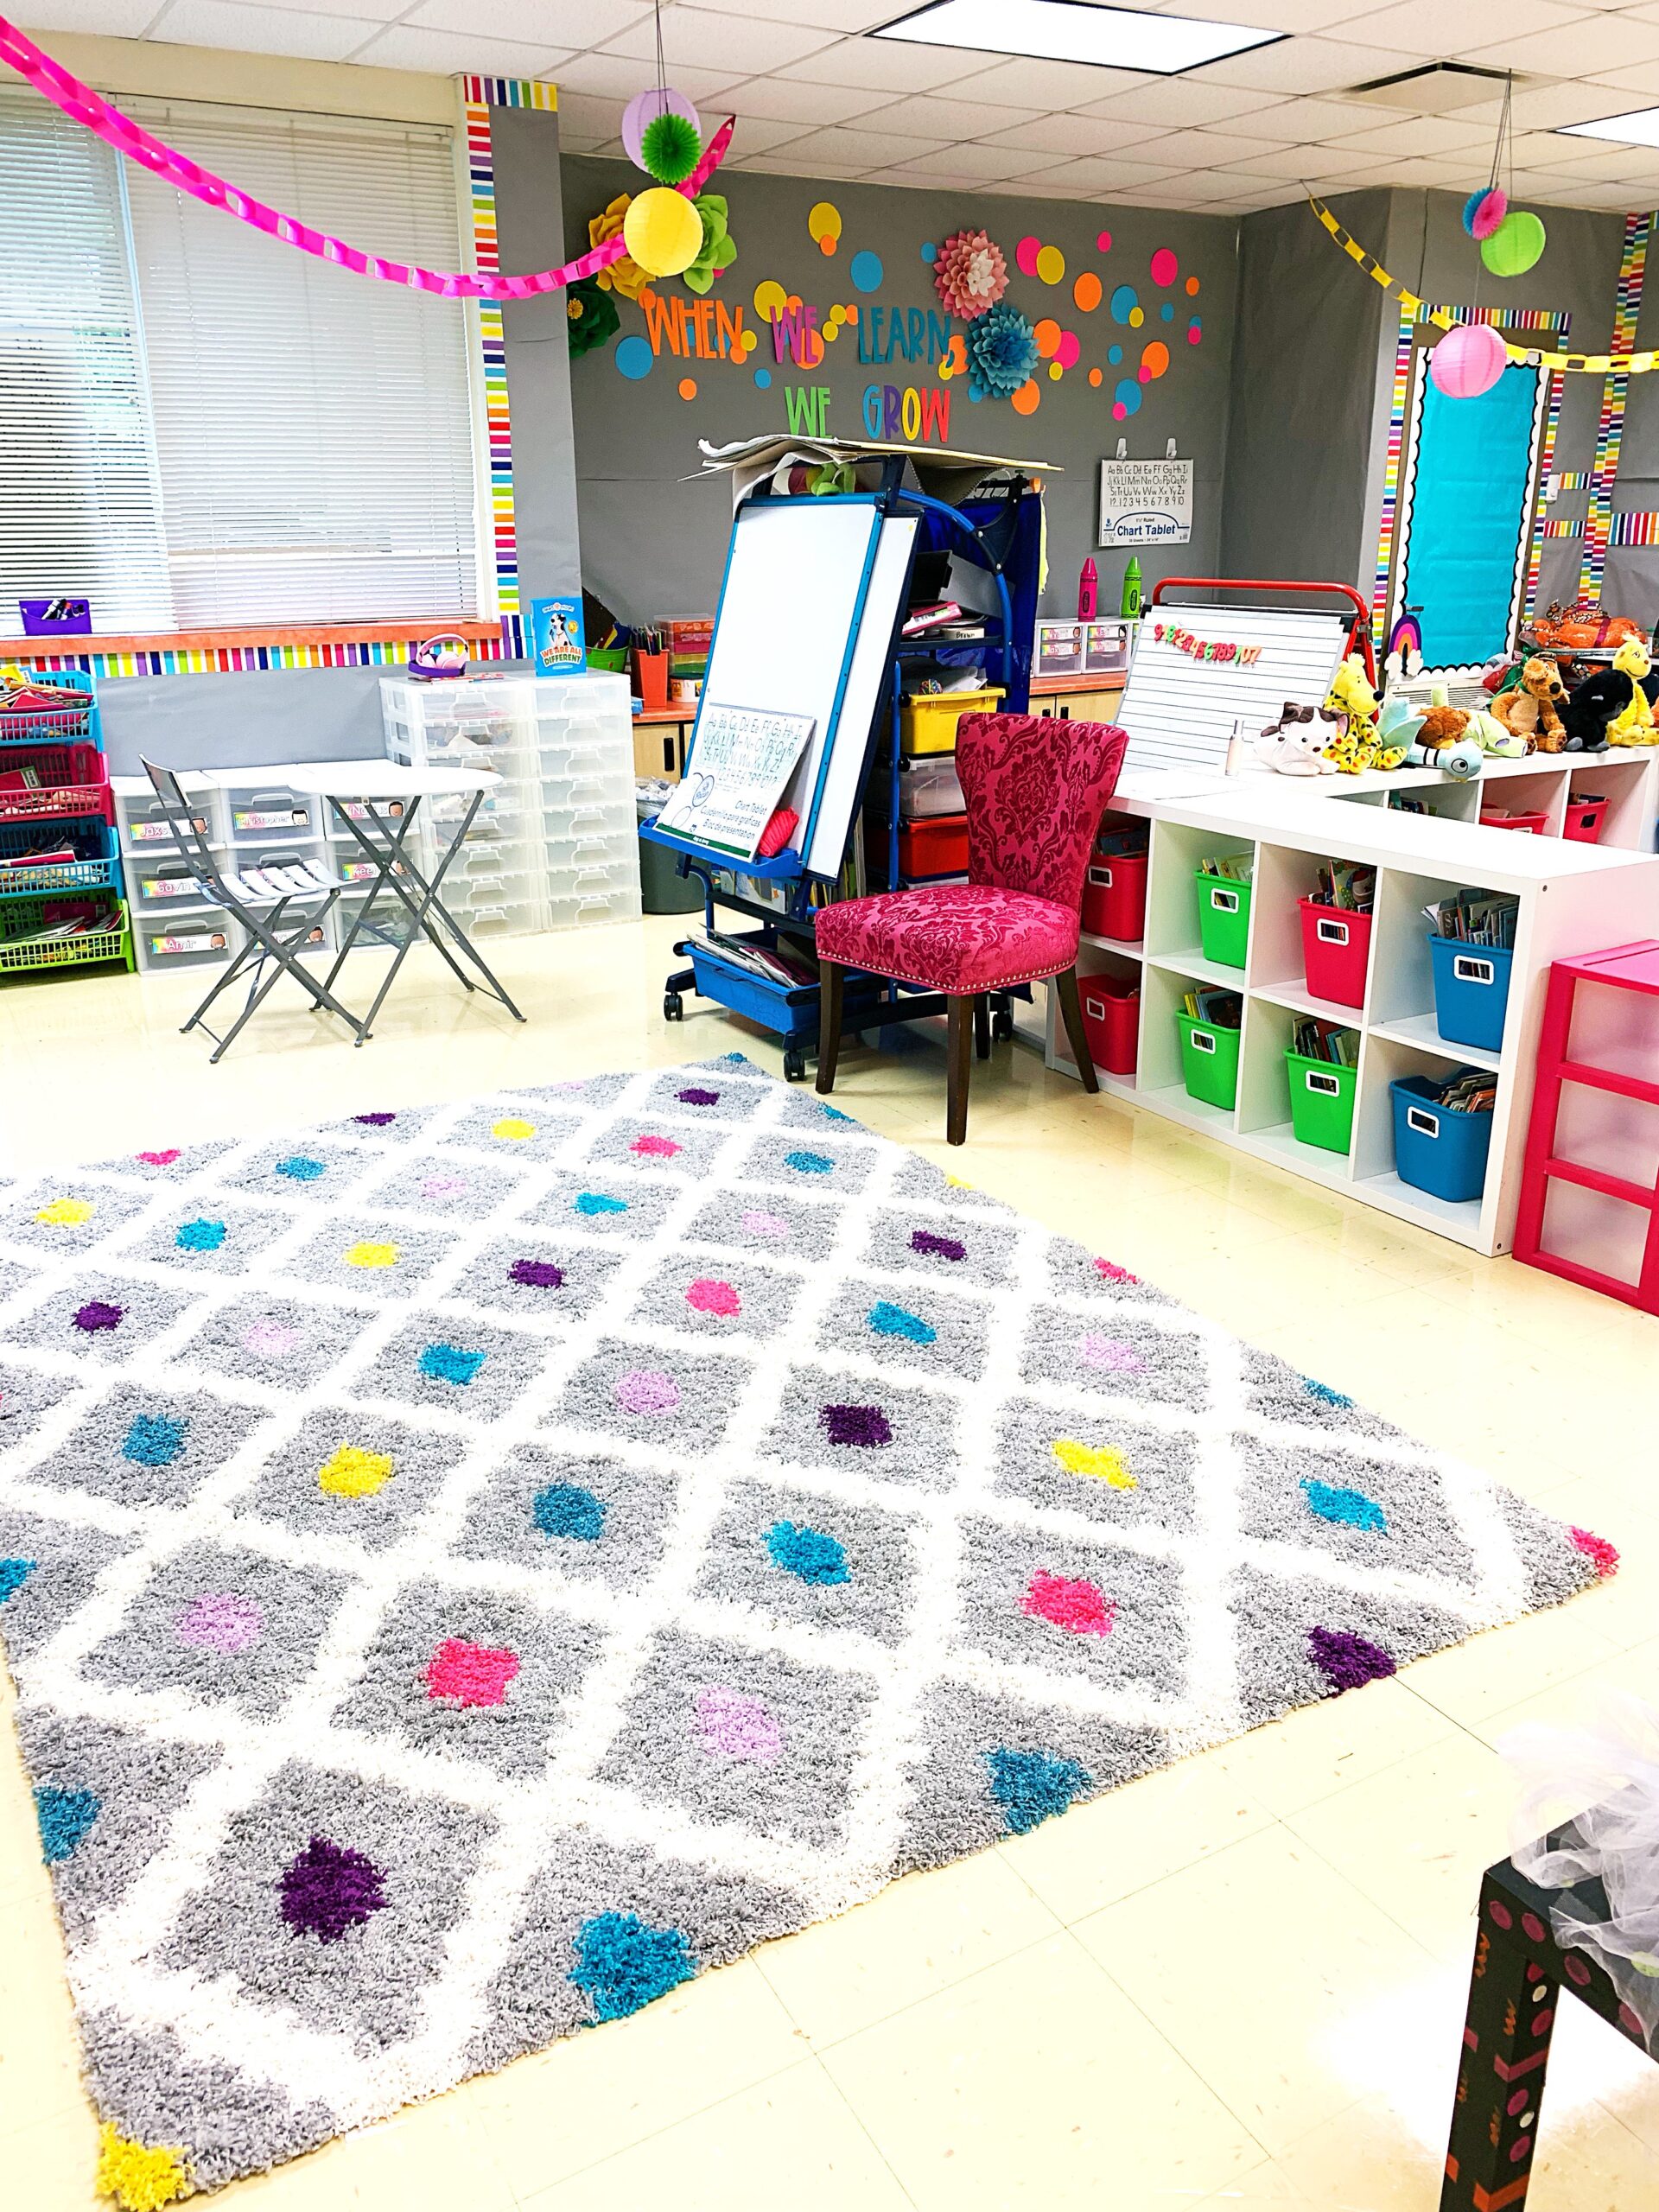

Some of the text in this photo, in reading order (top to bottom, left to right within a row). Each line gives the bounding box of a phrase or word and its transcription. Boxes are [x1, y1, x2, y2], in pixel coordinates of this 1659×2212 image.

[644, 296, 743, 359] WHEN
[770, 305, 818, 364] WE
[784, 385, 950, 442] WE GROW
[1117, 524, 1175, 536] Chart Tablet
[541, 645, 582, 658] WE ARE ALL
[544, 654, 581, 665] DIFFERENT
[157, 882, 191, 893] Gavin
[167, 939, 196, 950] Amir
